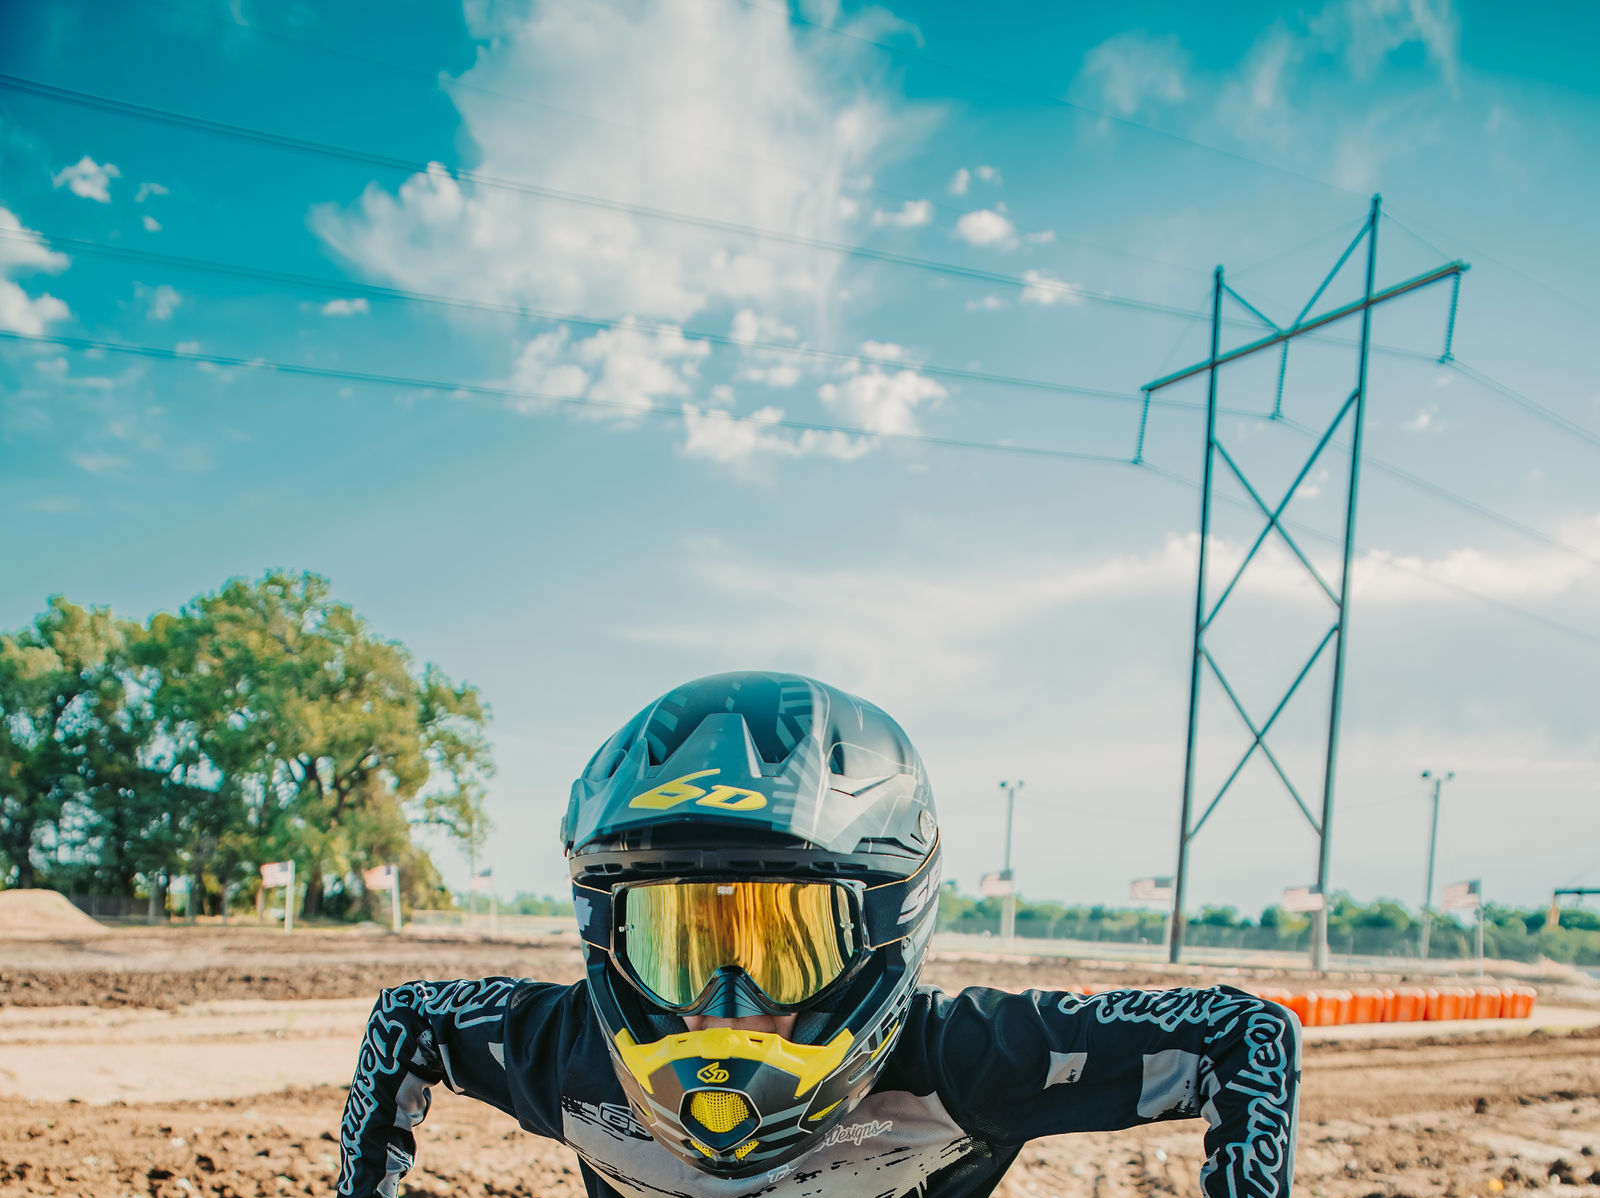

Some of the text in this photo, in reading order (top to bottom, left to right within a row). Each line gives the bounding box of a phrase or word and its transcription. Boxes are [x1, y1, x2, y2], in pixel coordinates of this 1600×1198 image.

[629, 768, 767, 811] 6D
[697, 1062, 730, 1084] 6D
[823, 1120, 893, 1146] Designs
